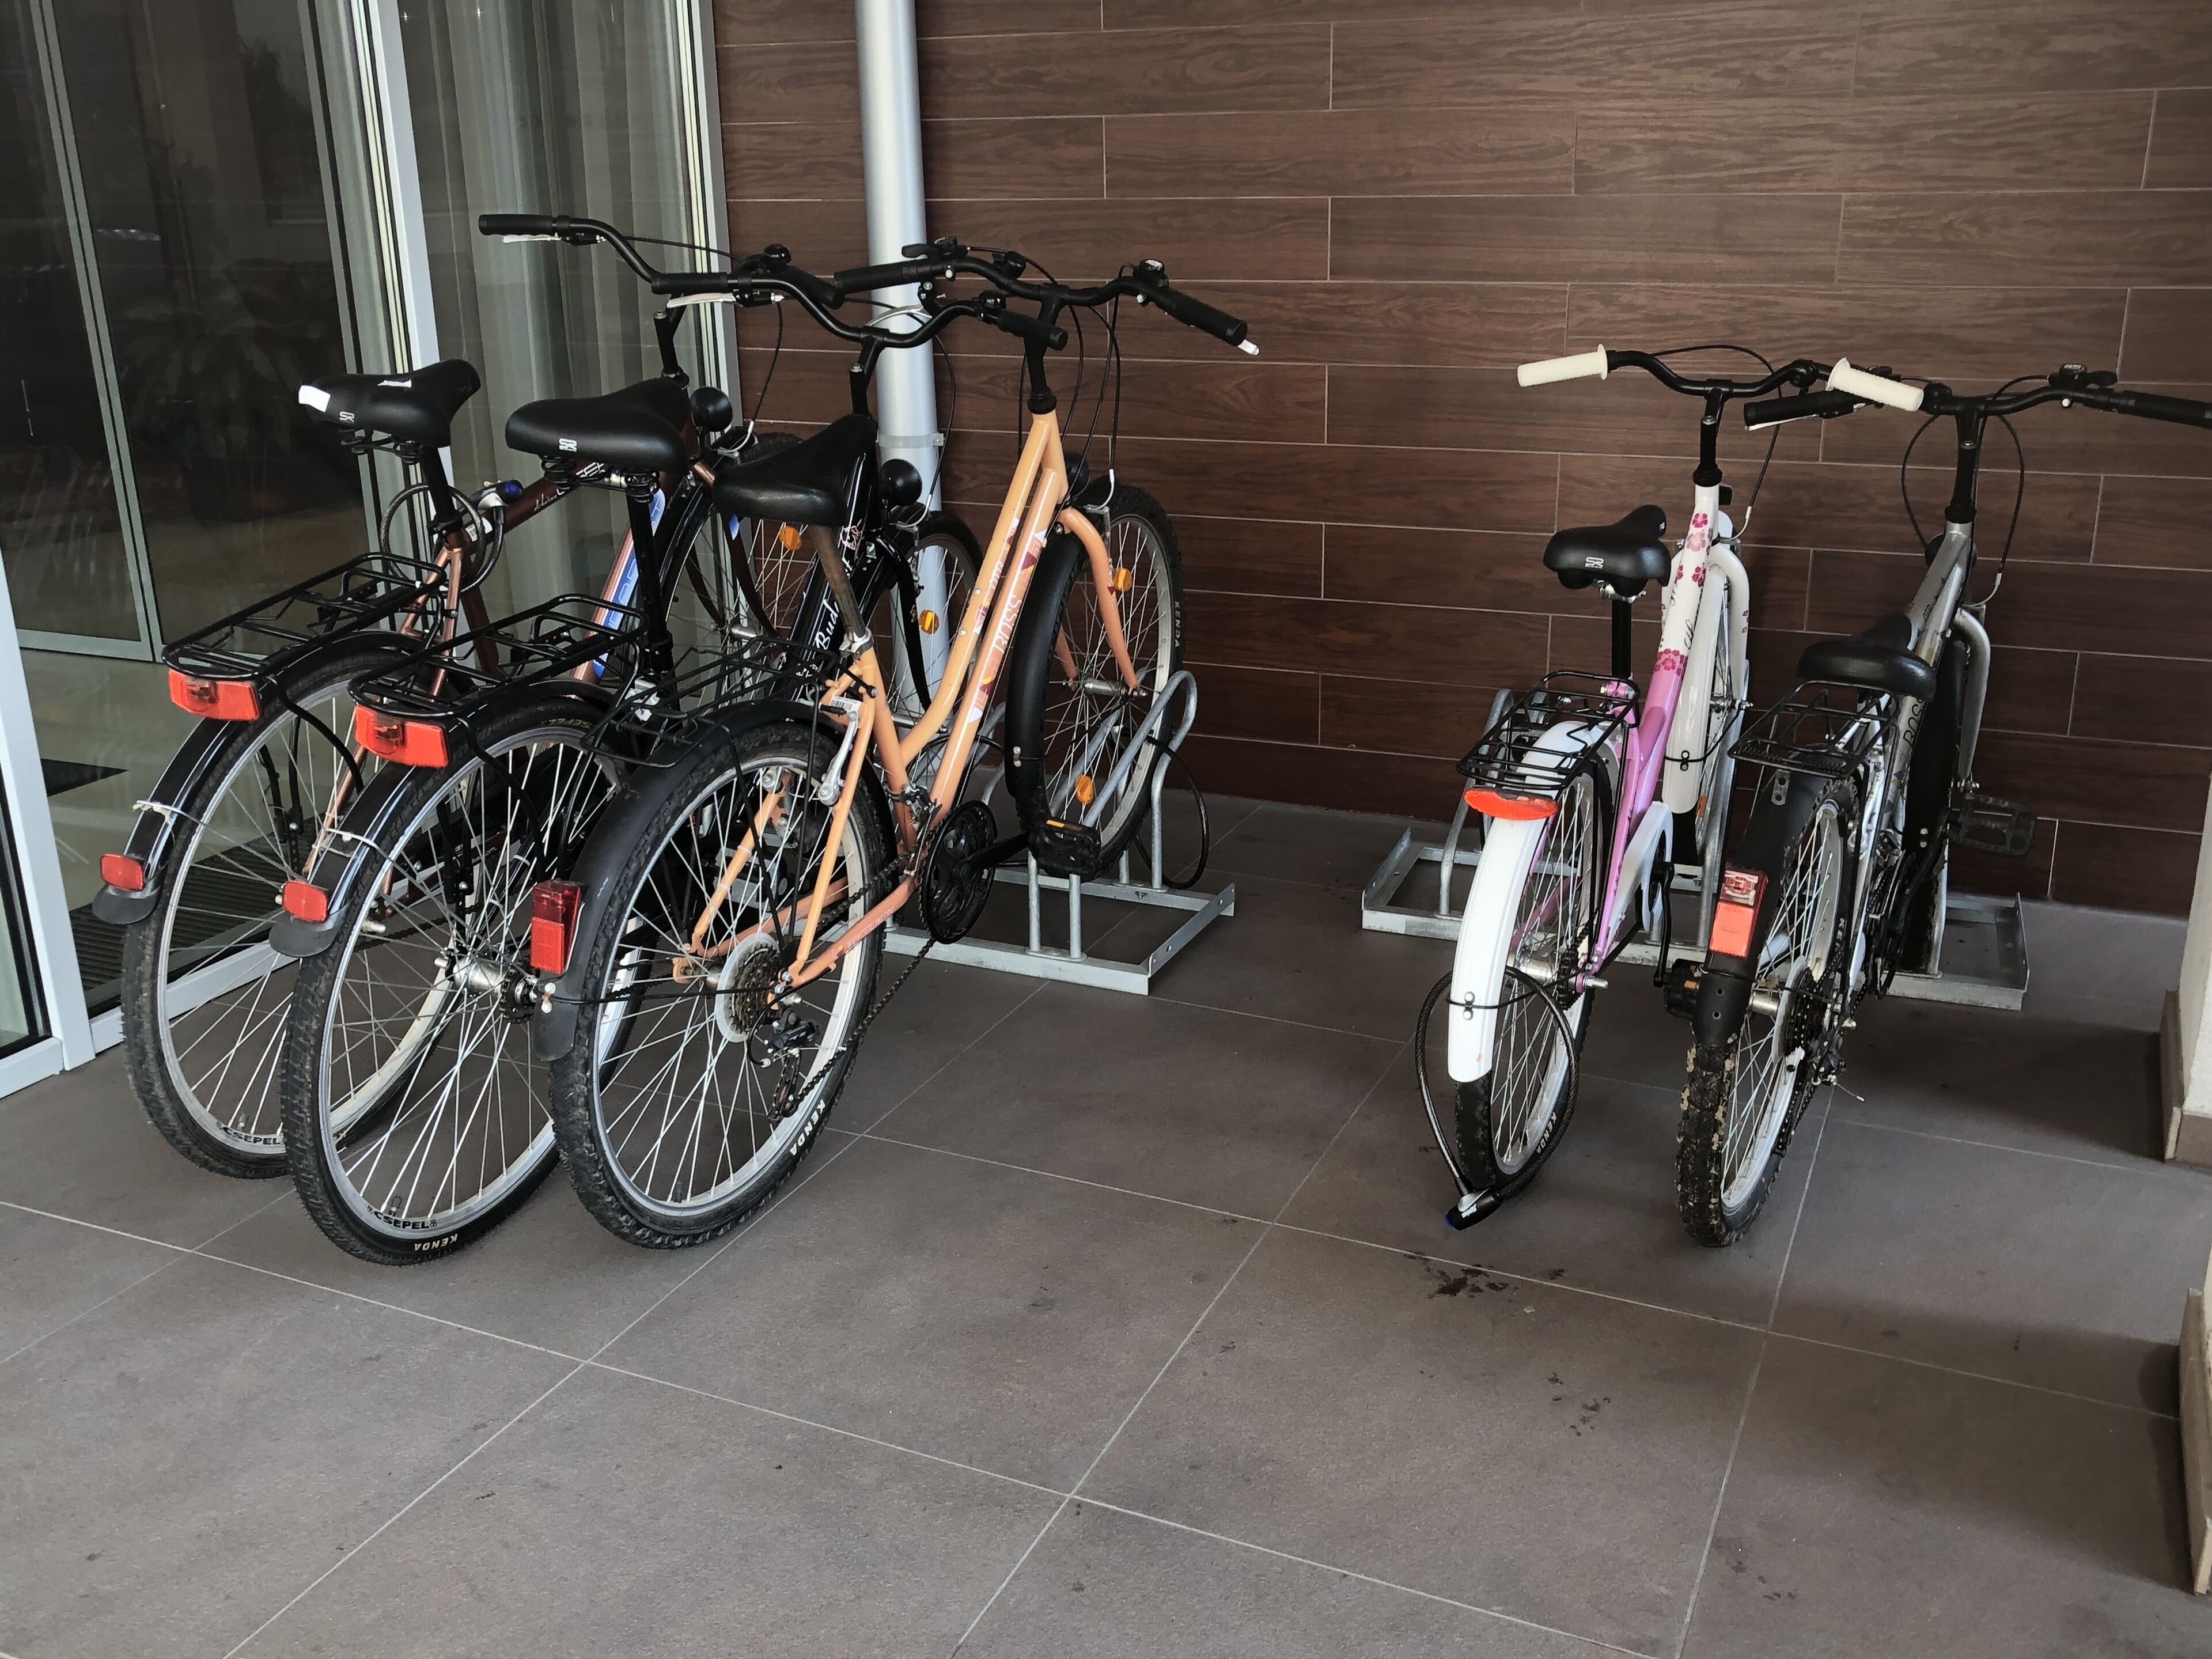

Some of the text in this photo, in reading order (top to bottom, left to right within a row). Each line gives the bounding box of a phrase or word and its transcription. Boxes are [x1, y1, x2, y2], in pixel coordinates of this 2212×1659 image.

[1903, 698, 1923, 747] BOS
[223, 1127, 281, 1145] CSEPEL
[789, 1099, 825, 1156] KENDA
[1536, 1111, 1556, 1154] KENDA
[374, 1210, 430, 1229] CSEPEL
[414, 1233, 458, 1251] KENDA
